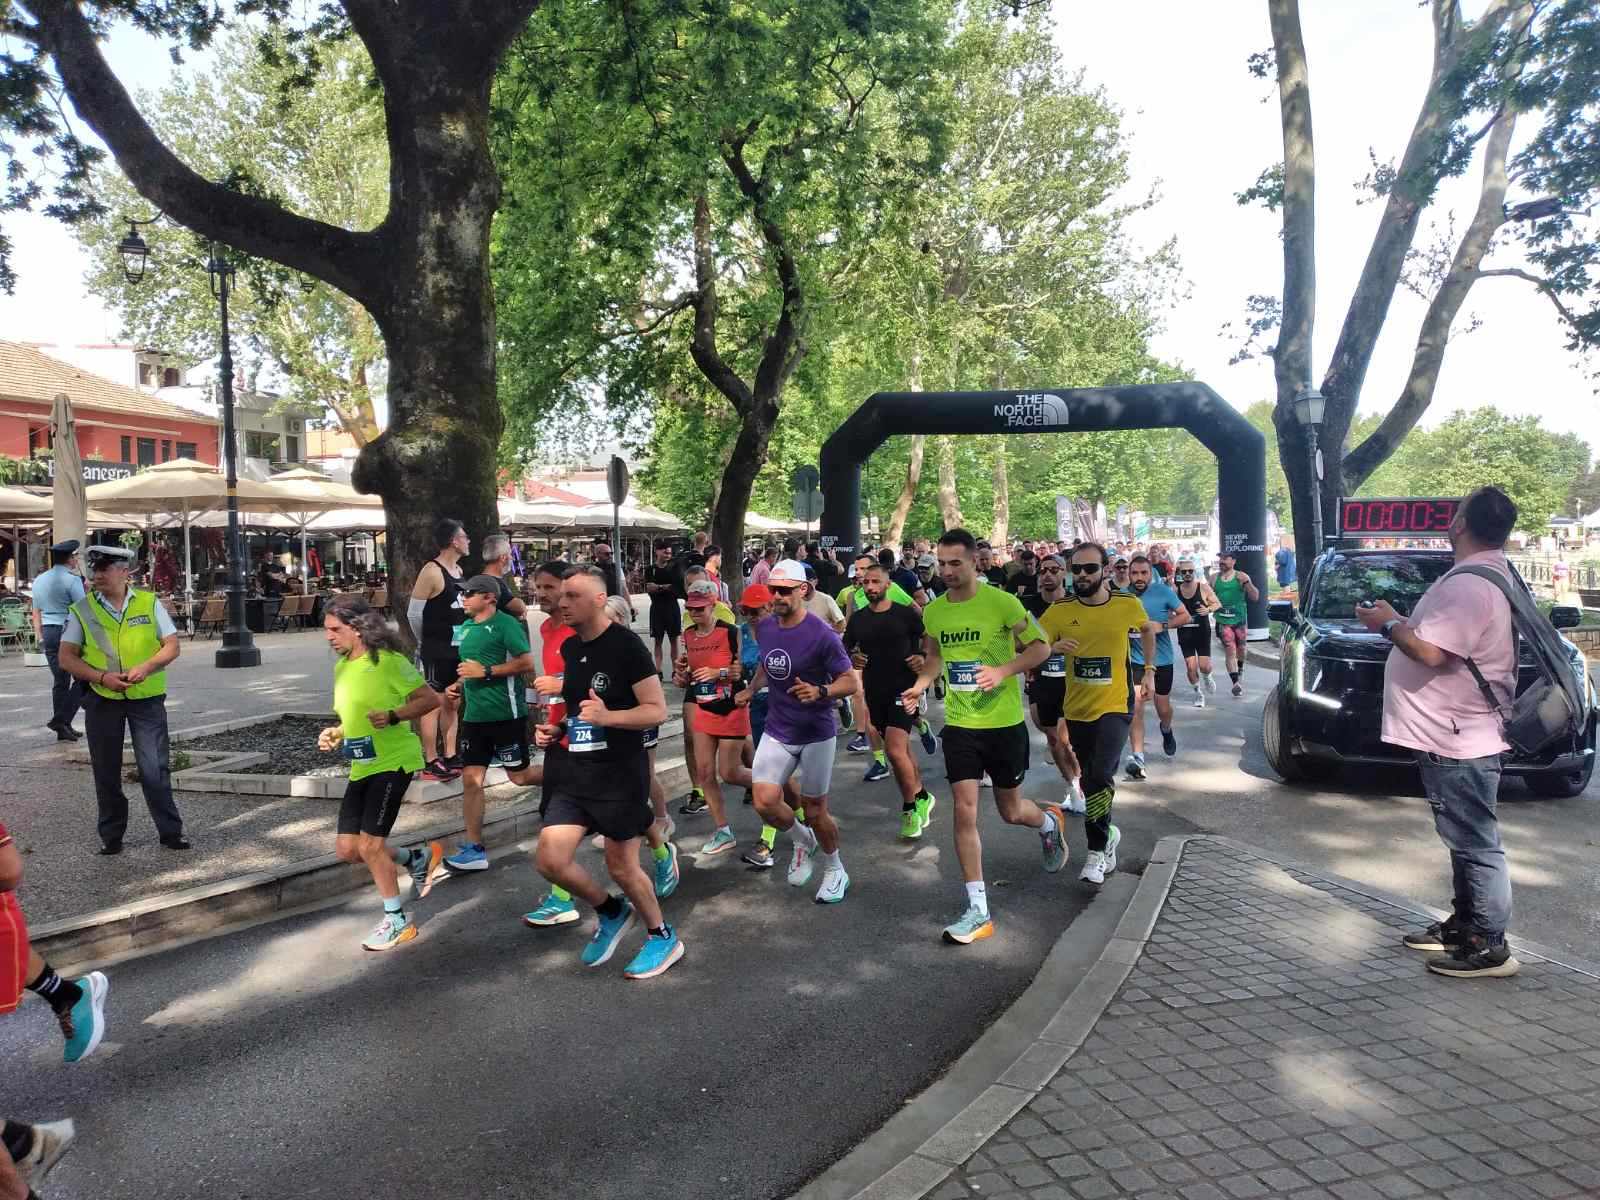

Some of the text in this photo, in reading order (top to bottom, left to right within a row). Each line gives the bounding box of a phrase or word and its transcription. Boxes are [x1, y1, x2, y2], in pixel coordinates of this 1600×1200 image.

[1016, 394, 1043, 404] THE
[994, 404, 1042, 416] NORTH
[1008, 416, 1043, 426] FACE
[940, 627, 980, 644] bwin
[768, 656, 786, 666] 360
[1081, 667, 1102, 676] 264
[957, 673, 972, 682] 200
[576, 730, 592, 741] 224
